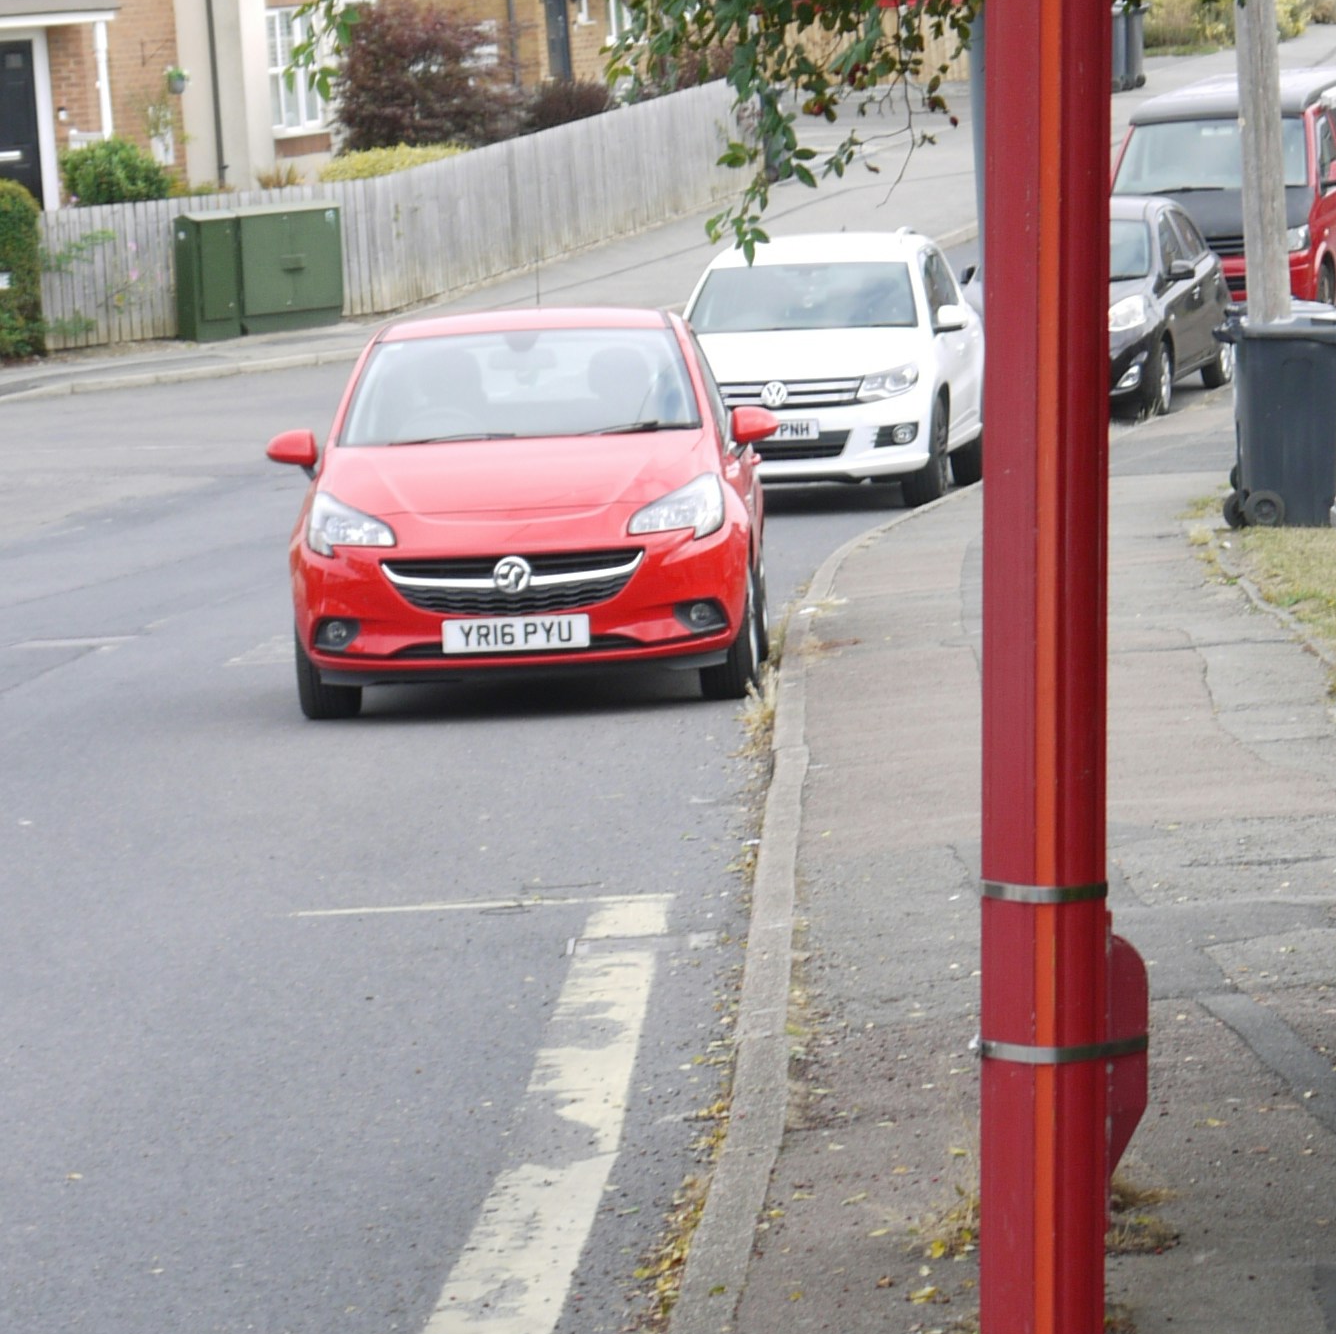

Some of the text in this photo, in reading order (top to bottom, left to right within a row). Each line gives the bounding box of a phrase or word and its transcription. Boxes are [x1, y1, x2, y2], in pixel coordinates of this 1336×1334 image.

[780, 421, 810, 437] PNH
[460, 620, 572, 647] YR16 PYU
